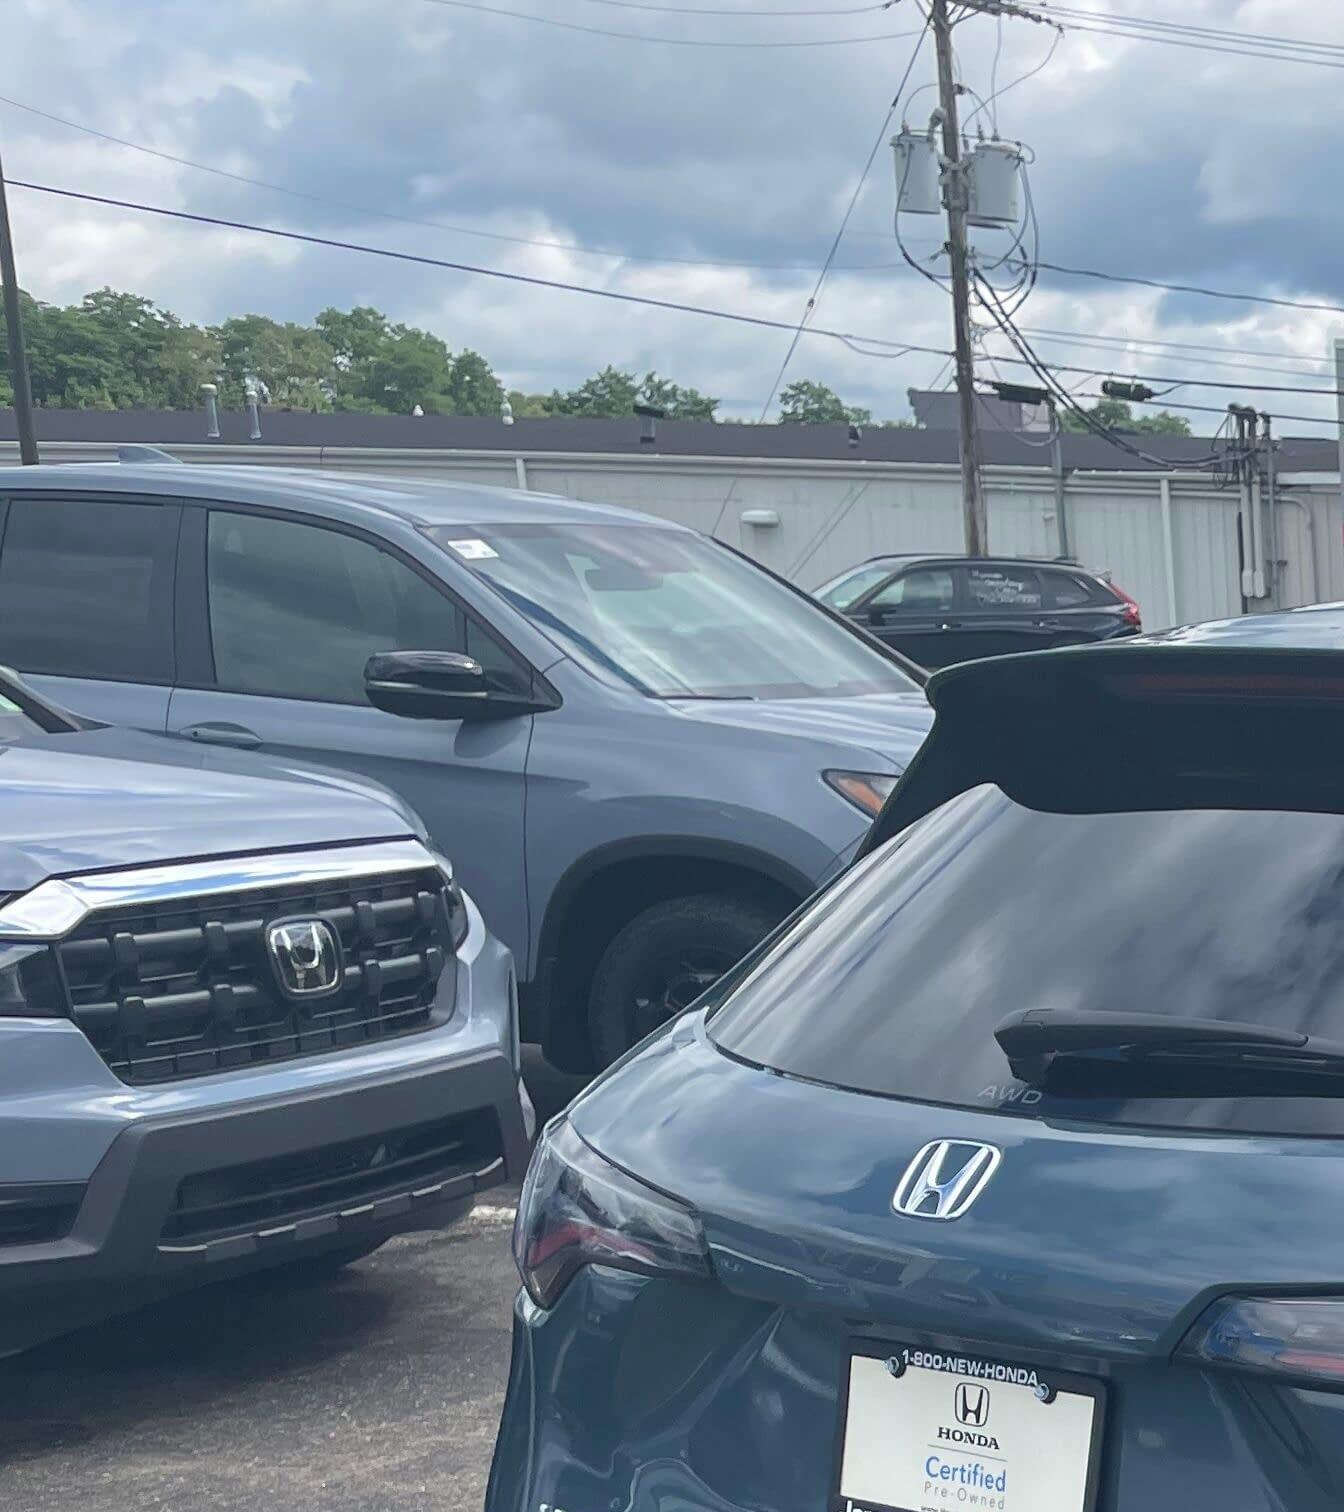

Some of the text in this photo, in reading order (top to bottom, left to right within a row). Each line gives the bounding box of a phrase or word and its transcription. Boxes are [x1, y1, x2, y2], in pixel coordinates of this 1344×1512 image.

[976, 1085, 1043, 1104] AWD
[902, 1349, 1038, 1387] 1-800-NEW-HONDA
[937, 1426, 1000, 1451] HONDA
[925, 1456, 1006, 1493] Certified
[924, 1481, 1005, 1510] Pre-Owned
